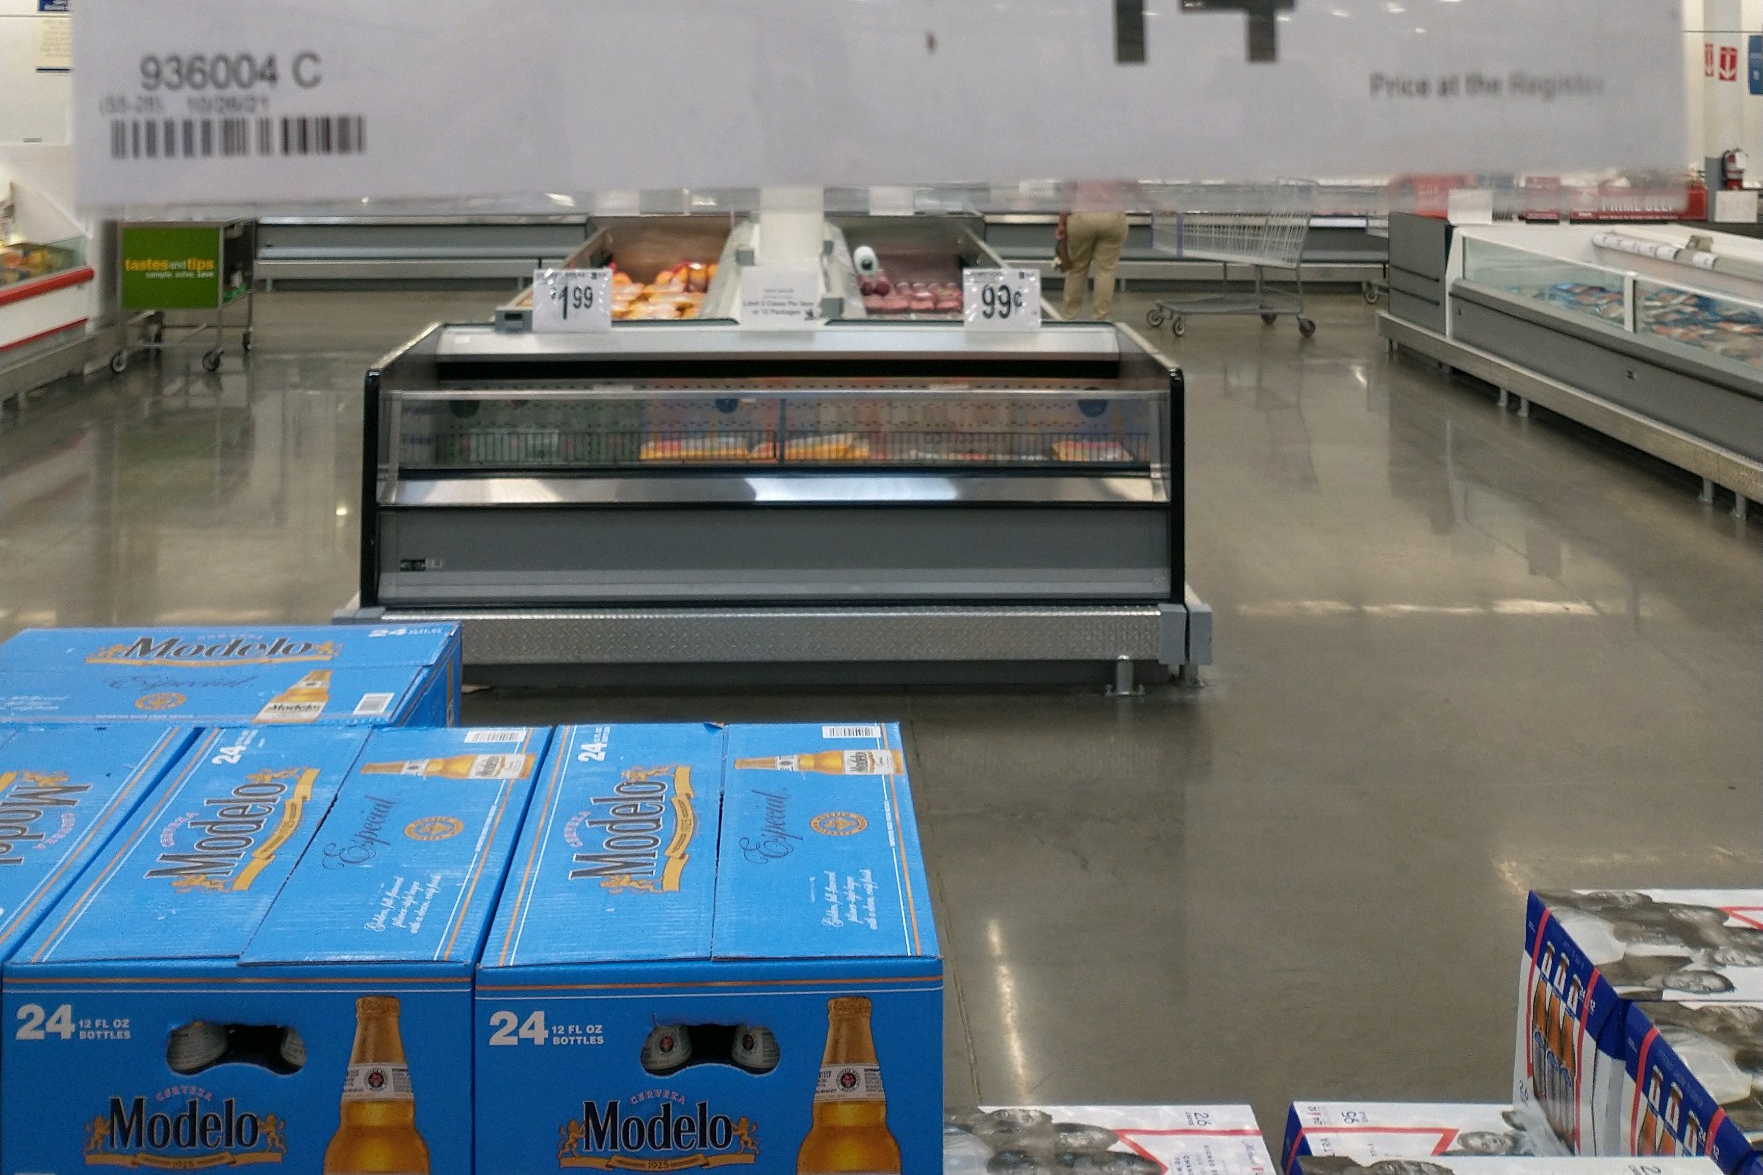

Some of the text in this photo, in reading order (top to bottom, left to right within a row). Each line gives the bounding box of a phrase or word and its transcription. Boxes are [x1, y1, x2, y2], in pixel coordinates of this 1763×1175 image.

[139, 50, 323, 91] 936004 C
[121, 635, 314, 660] Modelo
[211, 744, 248, 765] 24
[577, 740, 609, 762] 24
[143, 781, 289, 880] Modelo
[568, 780, 669, 881] Modelo
[15, 1003, 130, 1040] 24 12 FL OZ
[79, 1030, 131, 1040] BOTTLES
[488, 1010, 603, 1046] 24 12 FL OZ
[552, 1036, 605, 1045] BOTTLES
[629, 1088, 687, 1106] CERVEZA
[108, 1096, 260, 1150] Modelo
[582, 1099, 734, 1153] Modelo
